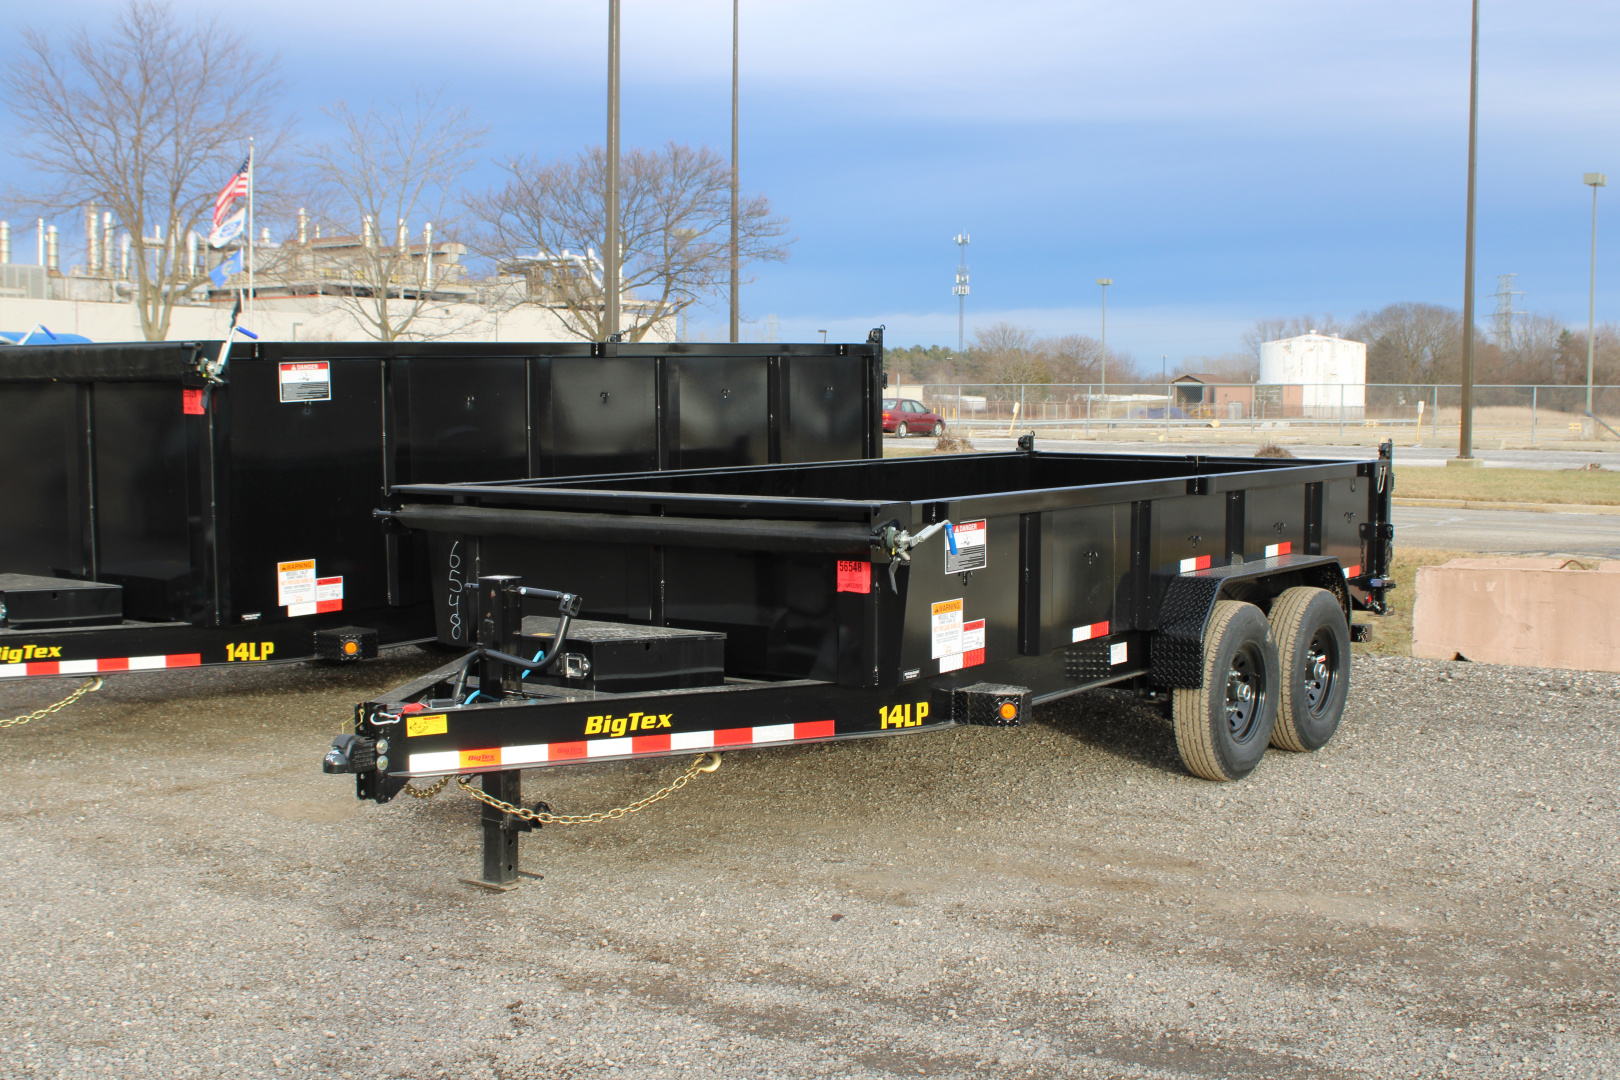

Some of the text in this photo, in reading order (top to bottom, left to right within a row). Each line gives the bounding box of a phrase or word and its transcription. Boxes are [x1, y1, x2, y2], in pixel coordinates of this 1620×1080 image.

[960, 523, 978, 532] DANGER
[286, 561, 312, 570] WARNING
[839, 561, 863, 573] 56548
[938, 601, 960, 612] WARNING
[0, 644, 63, 664] igTex
[225, 641, 274, 662] 14LP
[878, 701, 929, 730] 14LP
[584, 712, 673, 738] BigTex
[468, 754, 495, 762] BigTex
